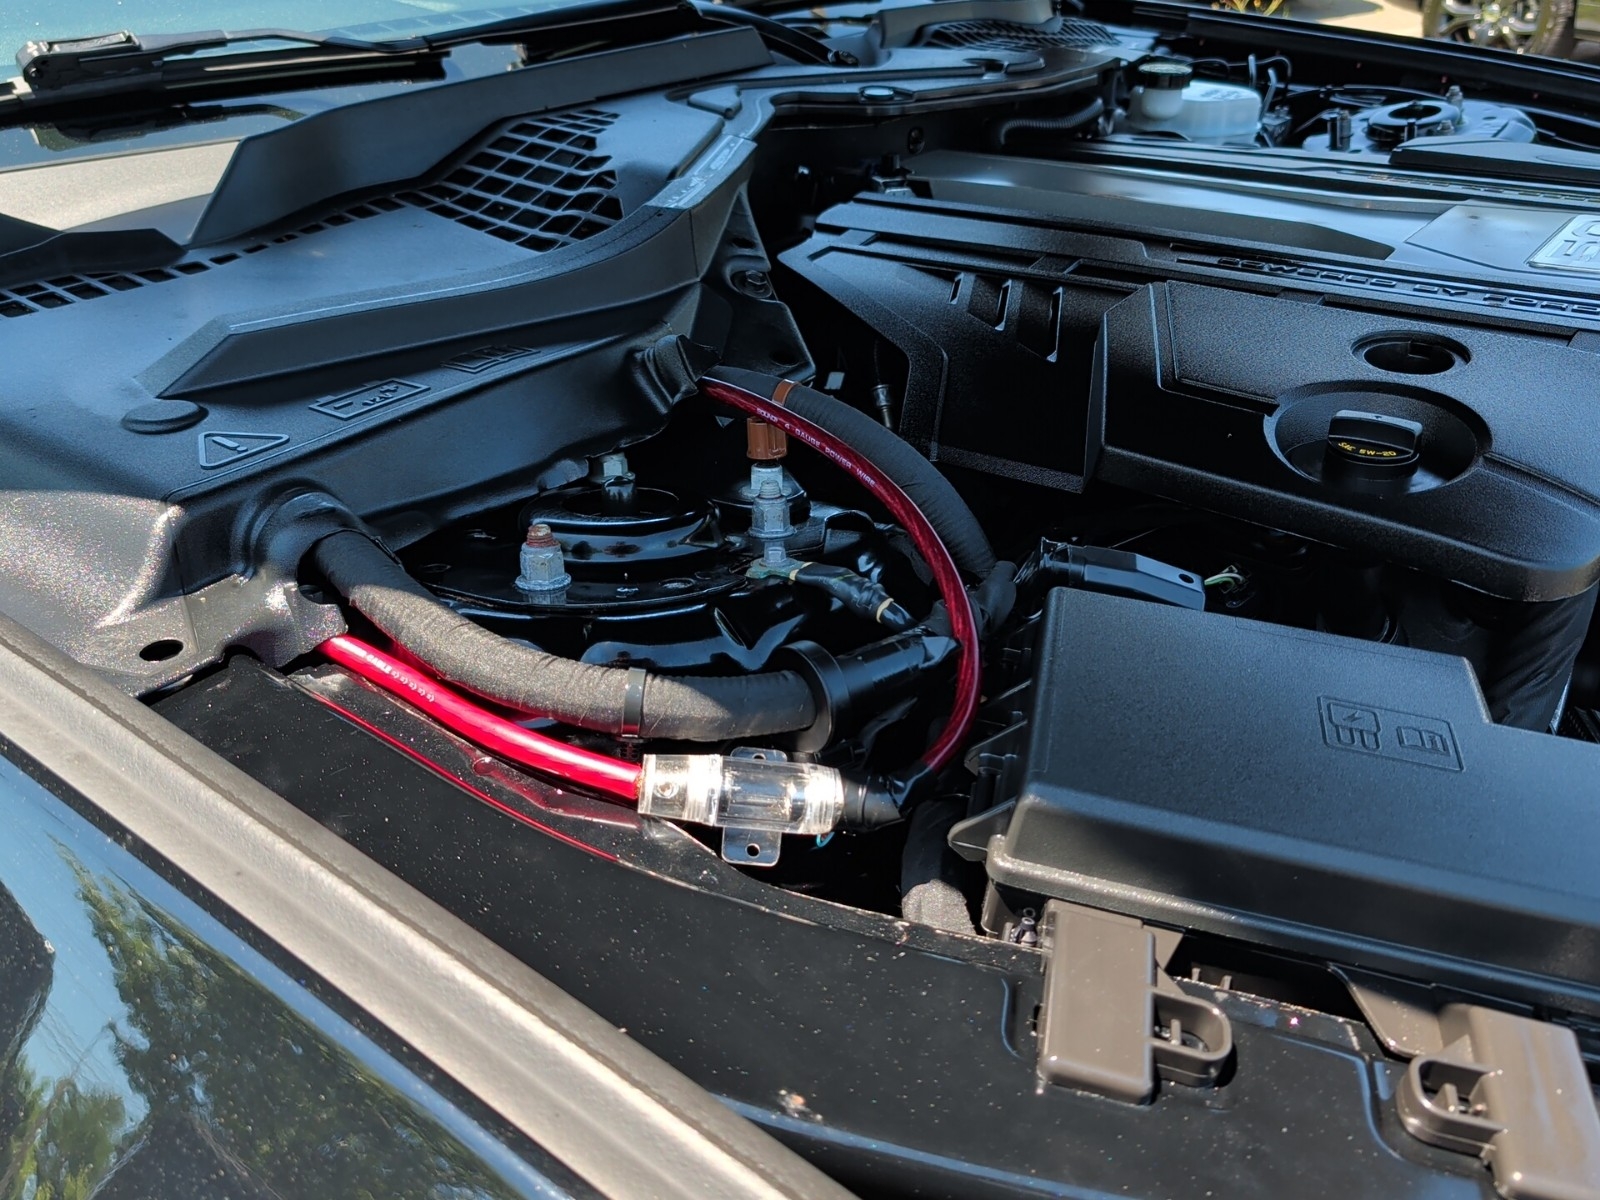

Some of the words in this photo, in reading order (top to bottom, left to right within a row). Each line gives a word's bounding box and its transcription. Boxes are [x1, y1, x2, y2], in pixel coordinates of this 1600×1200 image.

[1217, 256, 1397, 288] POWERED
[1413, 284, 1468, 296] BY
[1482, 293, 1600, 315] FORD
[794, 428, 820, 448] GAUGE
[825, 446, 852, 469] POWER
[856, 468, 876, 487] WIRE
[1338, 442, 1356, 451] SAE
[1359, 448, 1397, 457] 5W-20
